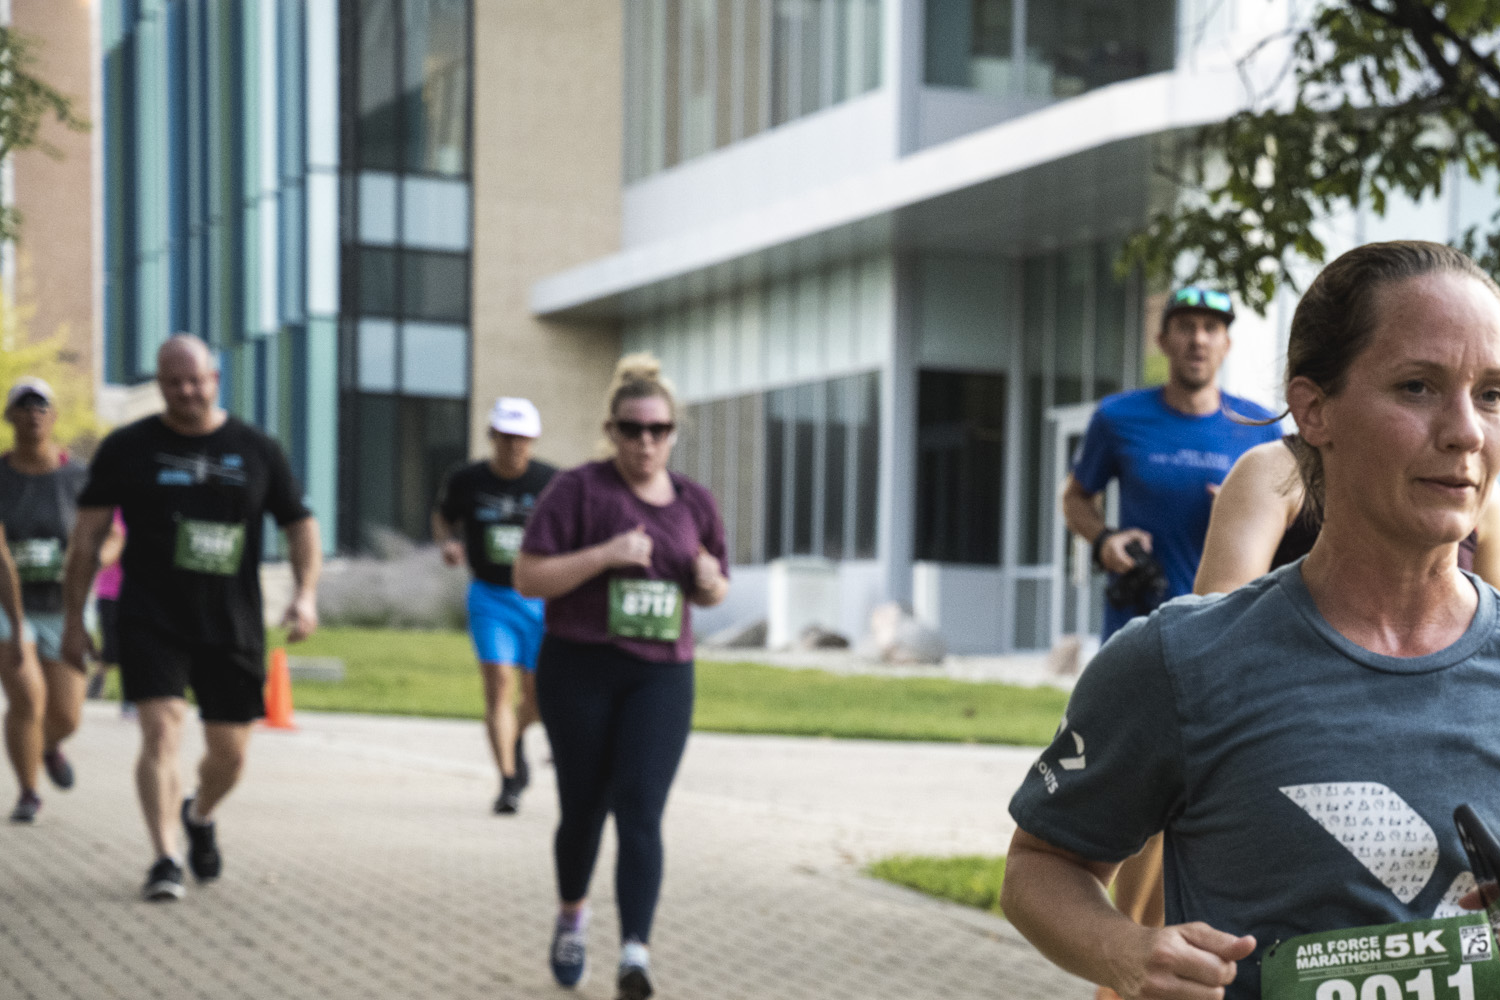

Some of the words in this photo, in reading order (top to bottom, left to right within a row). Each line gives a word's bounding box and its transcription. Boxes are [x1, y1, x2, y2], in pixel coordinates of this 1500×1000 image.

[1296, 942, 1323, 958] AIR
[1327, 935, 1380, 953] FORCE
[1384, 929, 1447, 958] 5K
[1296, 948, 1381, 970] MARATHON
